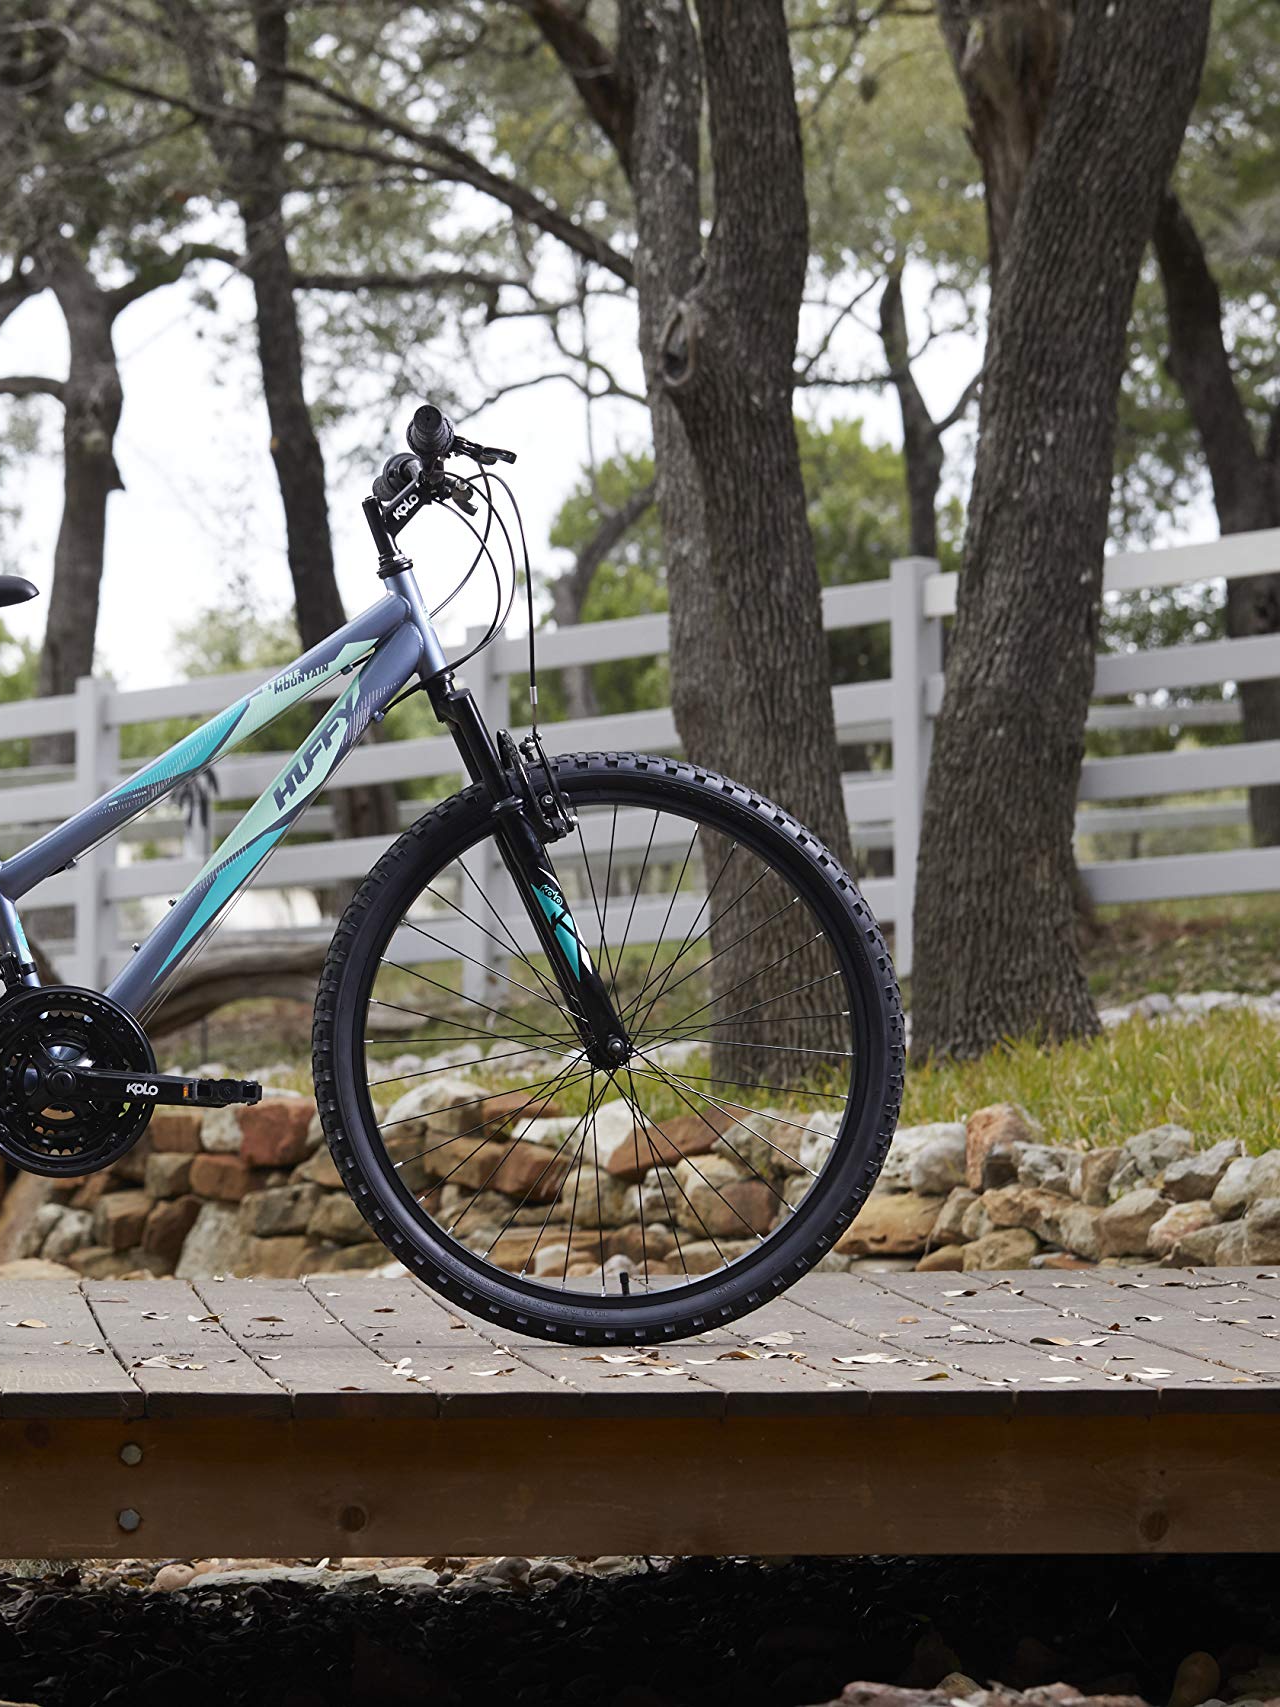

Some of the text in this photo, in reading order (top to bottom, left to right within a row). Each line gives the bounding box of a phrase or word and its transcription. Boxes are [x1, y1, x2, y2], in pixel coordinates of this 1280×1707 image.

[392, 493, 420, 520] KOLO
[274, 662, 329, 695] MOUNTAIN
[272, 691, 362, 811] HUFFY
[125, 1082, 158, 1096] KOLO
